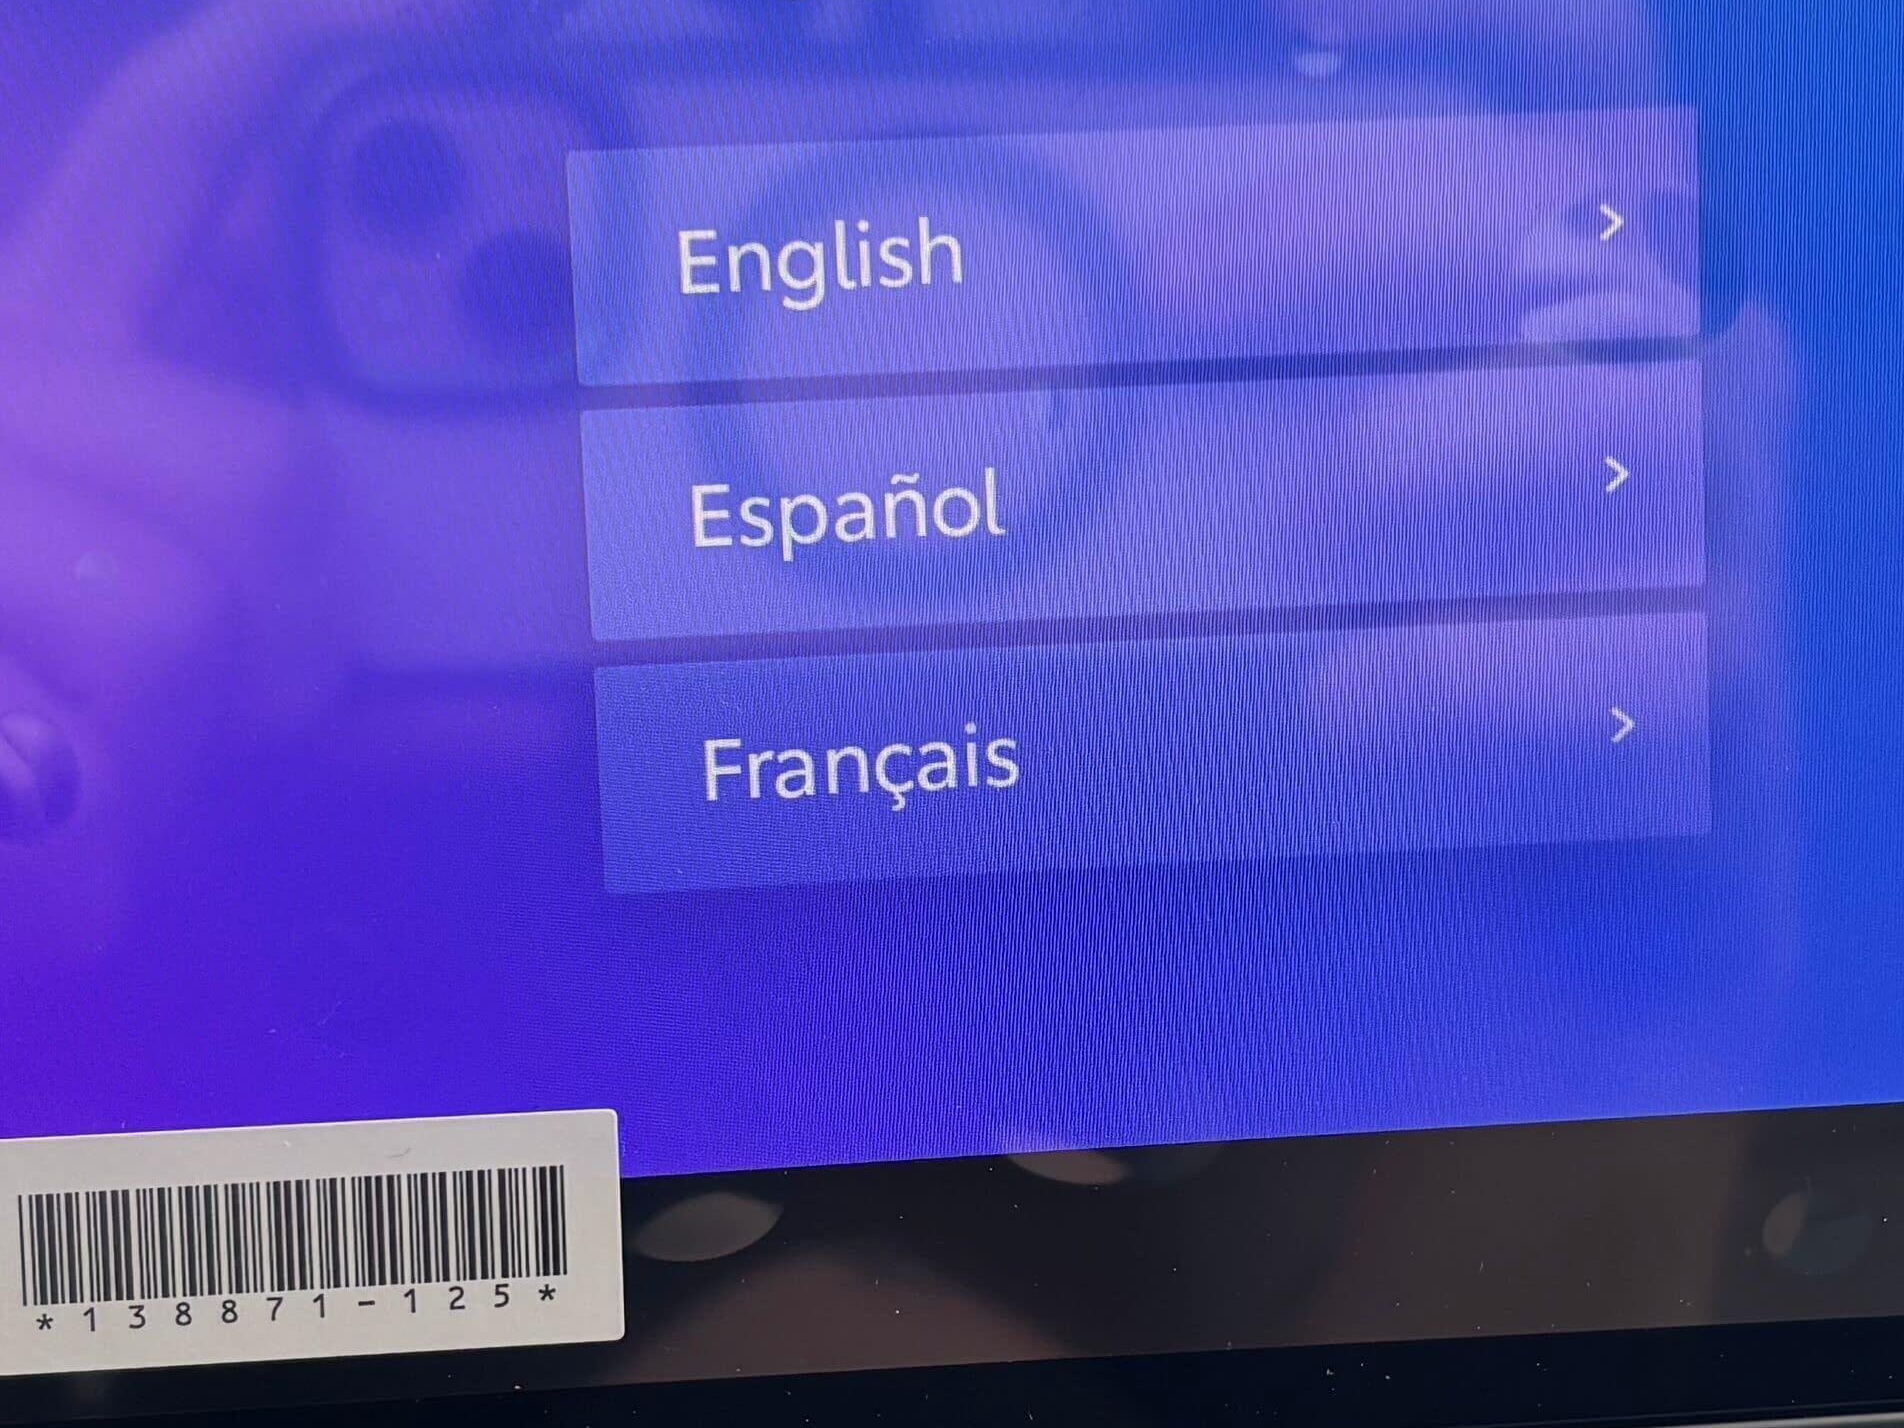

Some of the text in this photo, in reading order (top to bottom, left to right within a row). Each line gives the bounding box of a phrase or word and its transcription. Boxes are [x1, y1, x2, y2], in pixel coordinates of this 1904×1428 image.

[676, 217, 964, 312] English
[689, 467, 1007, 562] Español
[702, 723, 1021, 811] Français
